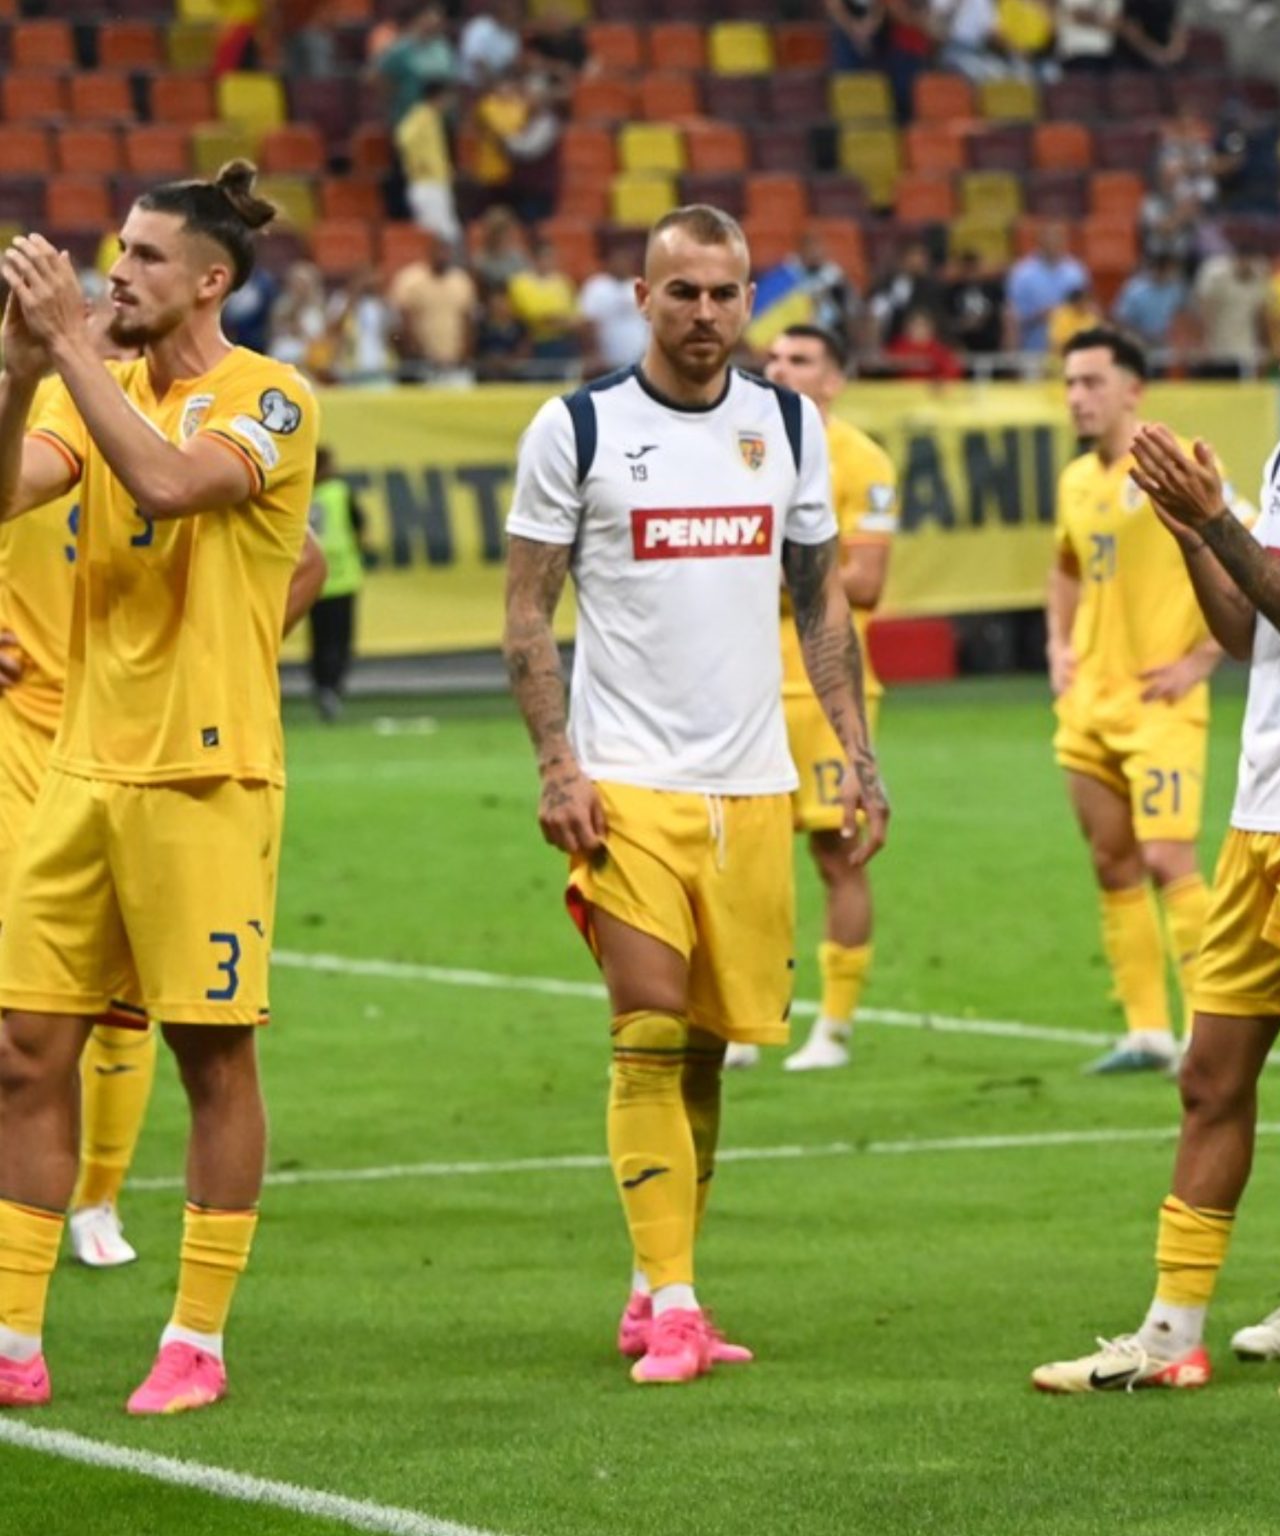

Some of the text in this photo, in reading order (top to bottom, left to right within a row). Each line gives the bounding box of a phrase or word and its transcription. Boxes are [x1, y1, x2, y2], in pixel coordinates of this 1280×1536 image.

[630, 464, 648, 482] 19
[1142, 769, 1181, 816] 21
[206, 932, 241, 1000] 3
